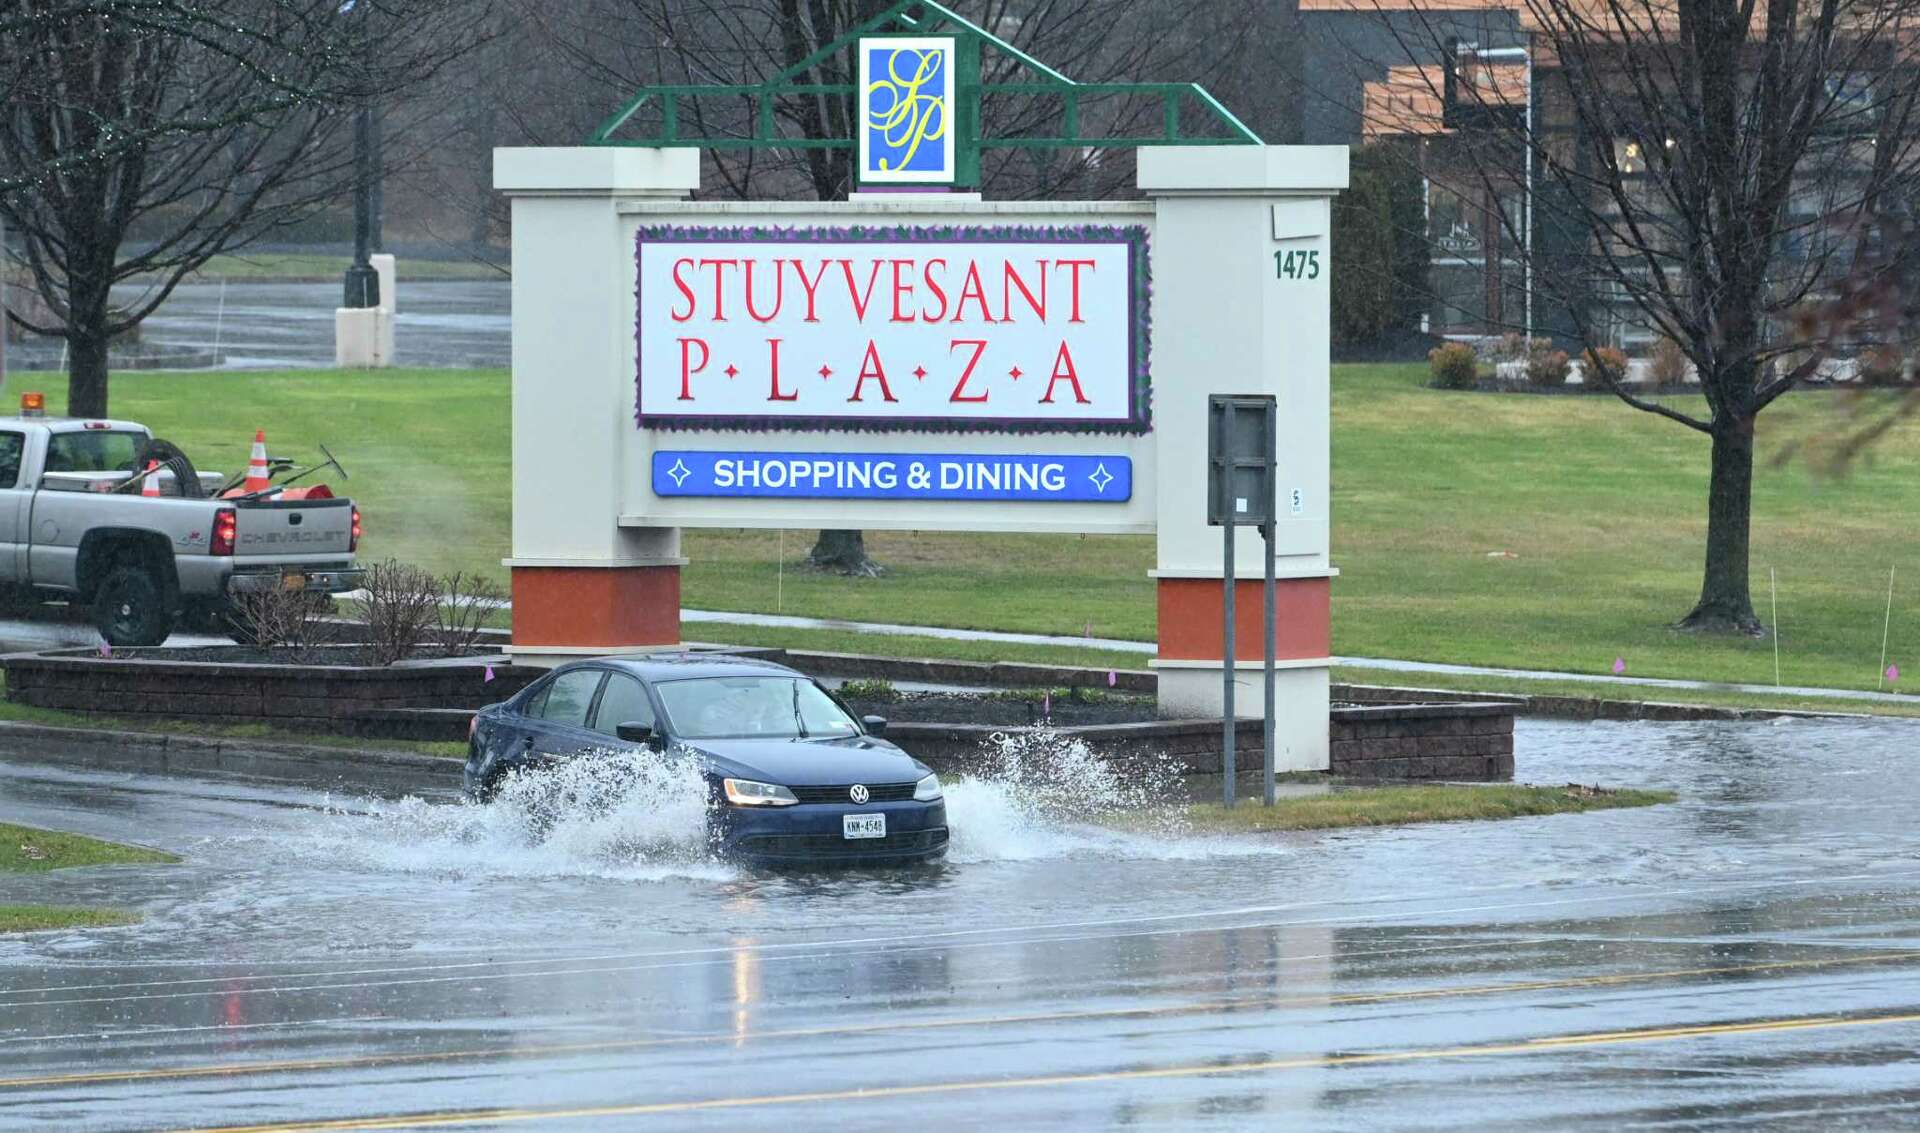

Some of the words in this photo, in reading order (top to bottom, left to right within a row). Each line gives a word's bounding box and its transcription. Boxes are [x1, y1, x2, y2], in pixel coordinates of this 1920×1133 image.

[1273, 250, 1320, 280] 1475
[671, 257, 1096, 326] STUYVESANT
[713, 459, 898, 489] SHOPPING
[906, 464, 931, 490] &
[939, 463, 1067, 491] DINING
[241, 530, 346, 544] CHEVROLET
